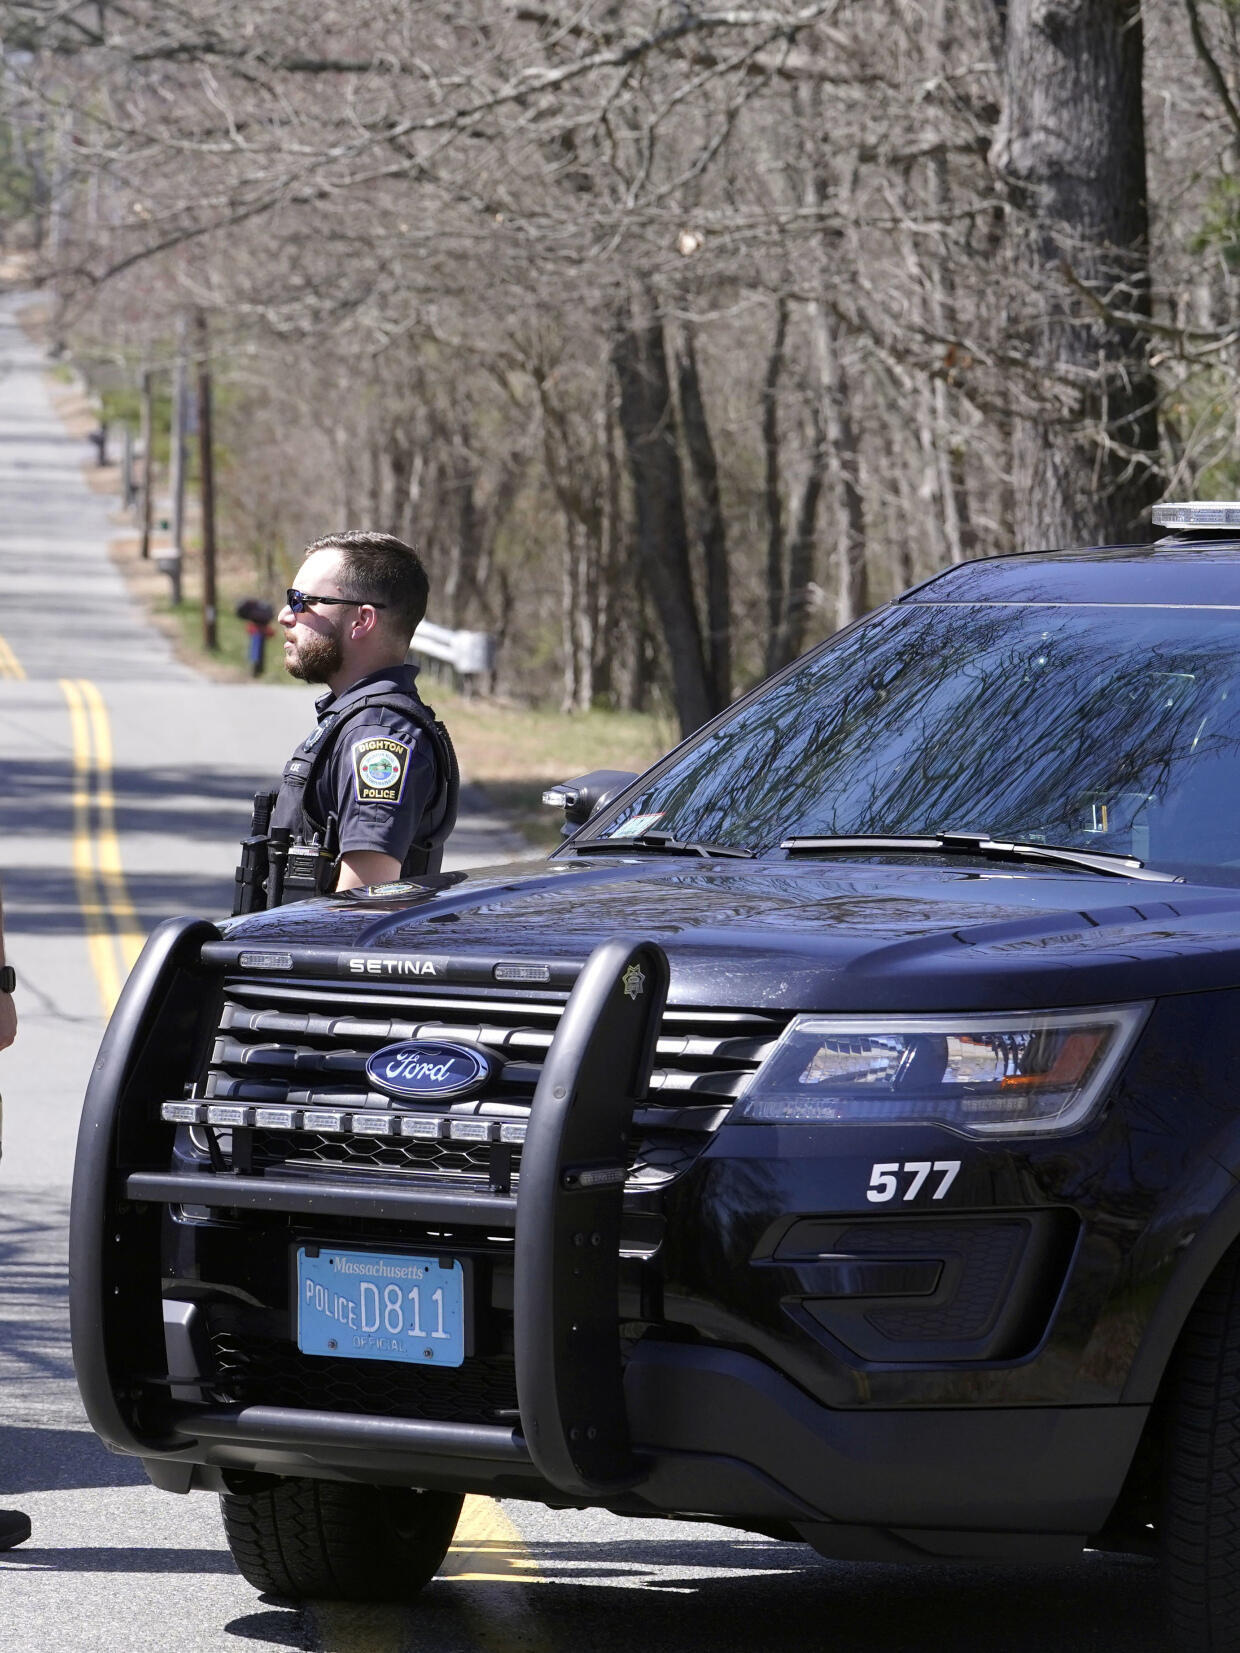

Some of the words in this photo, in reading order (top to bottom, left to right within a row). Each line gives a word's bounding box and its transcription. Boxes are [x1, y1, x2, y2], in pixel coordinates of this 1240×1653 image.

[358, 741, 404, 754] DIGHTON
[363, 789, 396, 799] POLICE
[349, 959, 436, 976] SETINA
[386, 1048, 456, 1082] Ford
[866, 1160, 961, 1202] 577
[333, 1256, 424, 1280] Massachusetts
[305, 1279, 358, 1330] POLICE
[360, 1281, 452, 1339] D811
